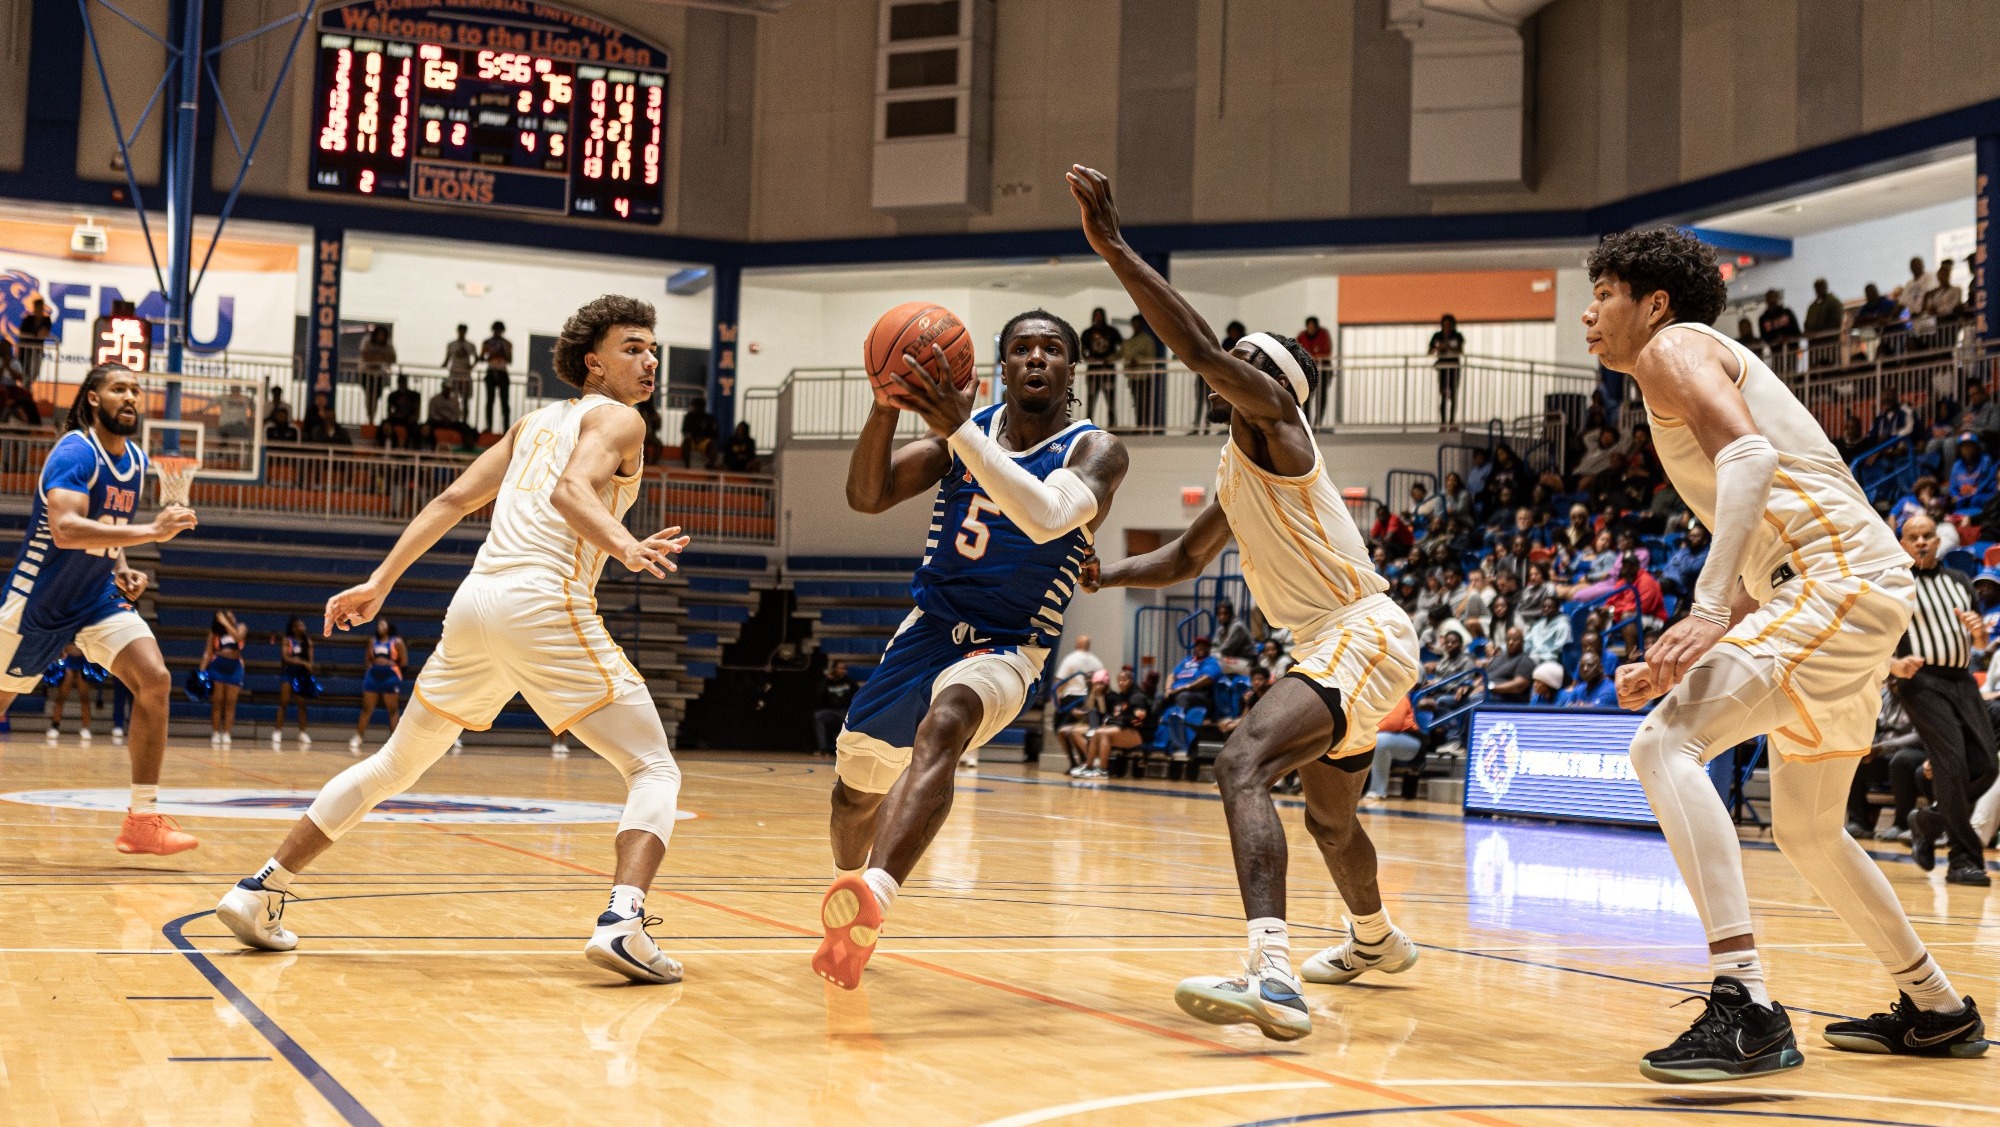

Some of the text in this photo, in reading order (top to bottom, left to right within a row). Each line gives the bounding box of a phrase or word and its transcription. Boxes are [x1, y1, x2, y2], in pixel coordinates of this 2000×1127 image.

[341, 6, 651, 67] Welcome to the Lion's Den
[424, 60, 458, 90] 62
[478, 50, 531, 83] 5:56
[541, 73, 572, 104] 76
[591, 80, 607, 101] 0
[615, 83, 635, 103] 11
[647, 86, 662, 107] 3
[517, 90, 533, 112] 2
[591, 100, 605, 119] 4
[618, 102, 634, 124] 9
[646, 106, 660, 125] 4
[426, 120, 441, 143] 6
[451, 123, 467, 146] 2
[590, 118, 604, 139] 5
[606, 120, 633, 142] 21
[357, 133, 377, 154] 11
[520, 131, 536, 153] 4
[549, 134, 565, 157] 5
[584, 138, 604, 158] 11
[644, 143, 660, 165] 0
[583, 157, 602, 179] 13
[644, 164, 659, 185] 3
[359, 170, 375, 193] 2
[417, 177, 494, 203] LIONS
[614, 198, 629, 218] 4
[1976, 174, 1989, 333] PHYSICA
[49, 282, 235, 358] FMU
[314, 241, 340, 392] MEMORIA
[98, 331, 145, 371] 26
[718, 323, 737, 397] WAY
[103, 484, 136, 513] FMU
[954, 493, 1000, 561] 5
